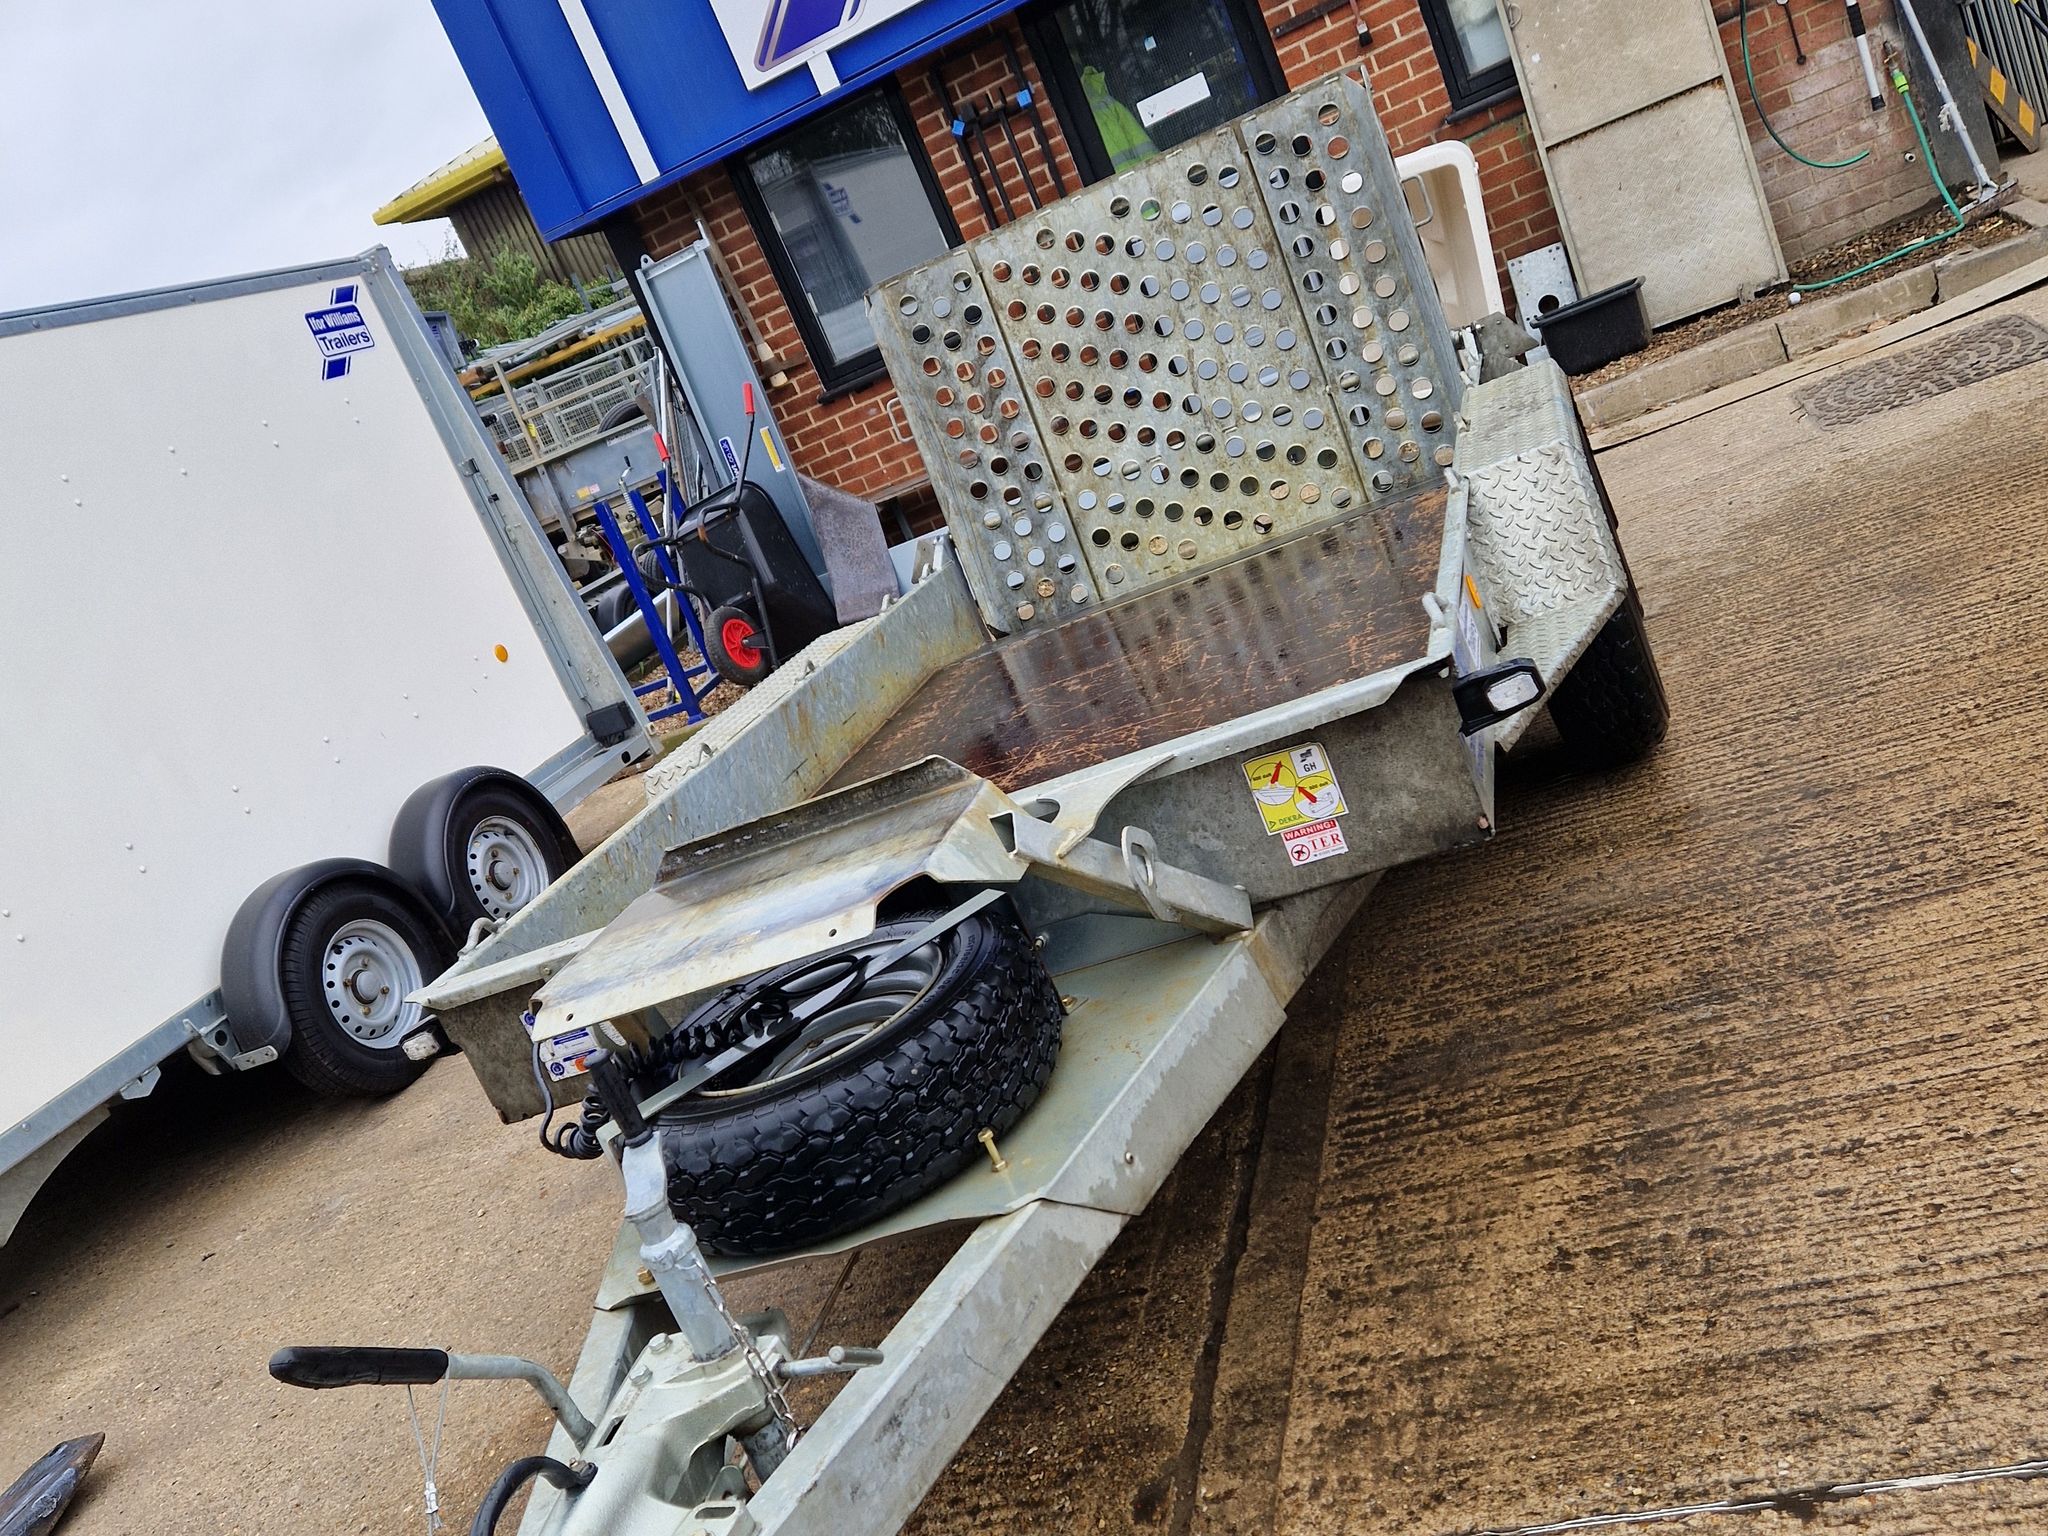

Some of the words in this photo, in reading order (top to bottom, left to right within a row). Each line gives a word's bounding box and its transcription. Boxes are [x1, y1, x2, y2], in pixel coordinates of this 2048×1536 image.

[308, 317, 326, 331] Ifor
[323, 311, 360, 328] Williams
[318, 332, 370, 351] Trailers
[1303, 762, 1317, 773] GH
[1278, 814, 1304, 825] DEKRA
[1284, 821, 1336, 841] WARNING!
[1308, 833, 1342, 850] TER
